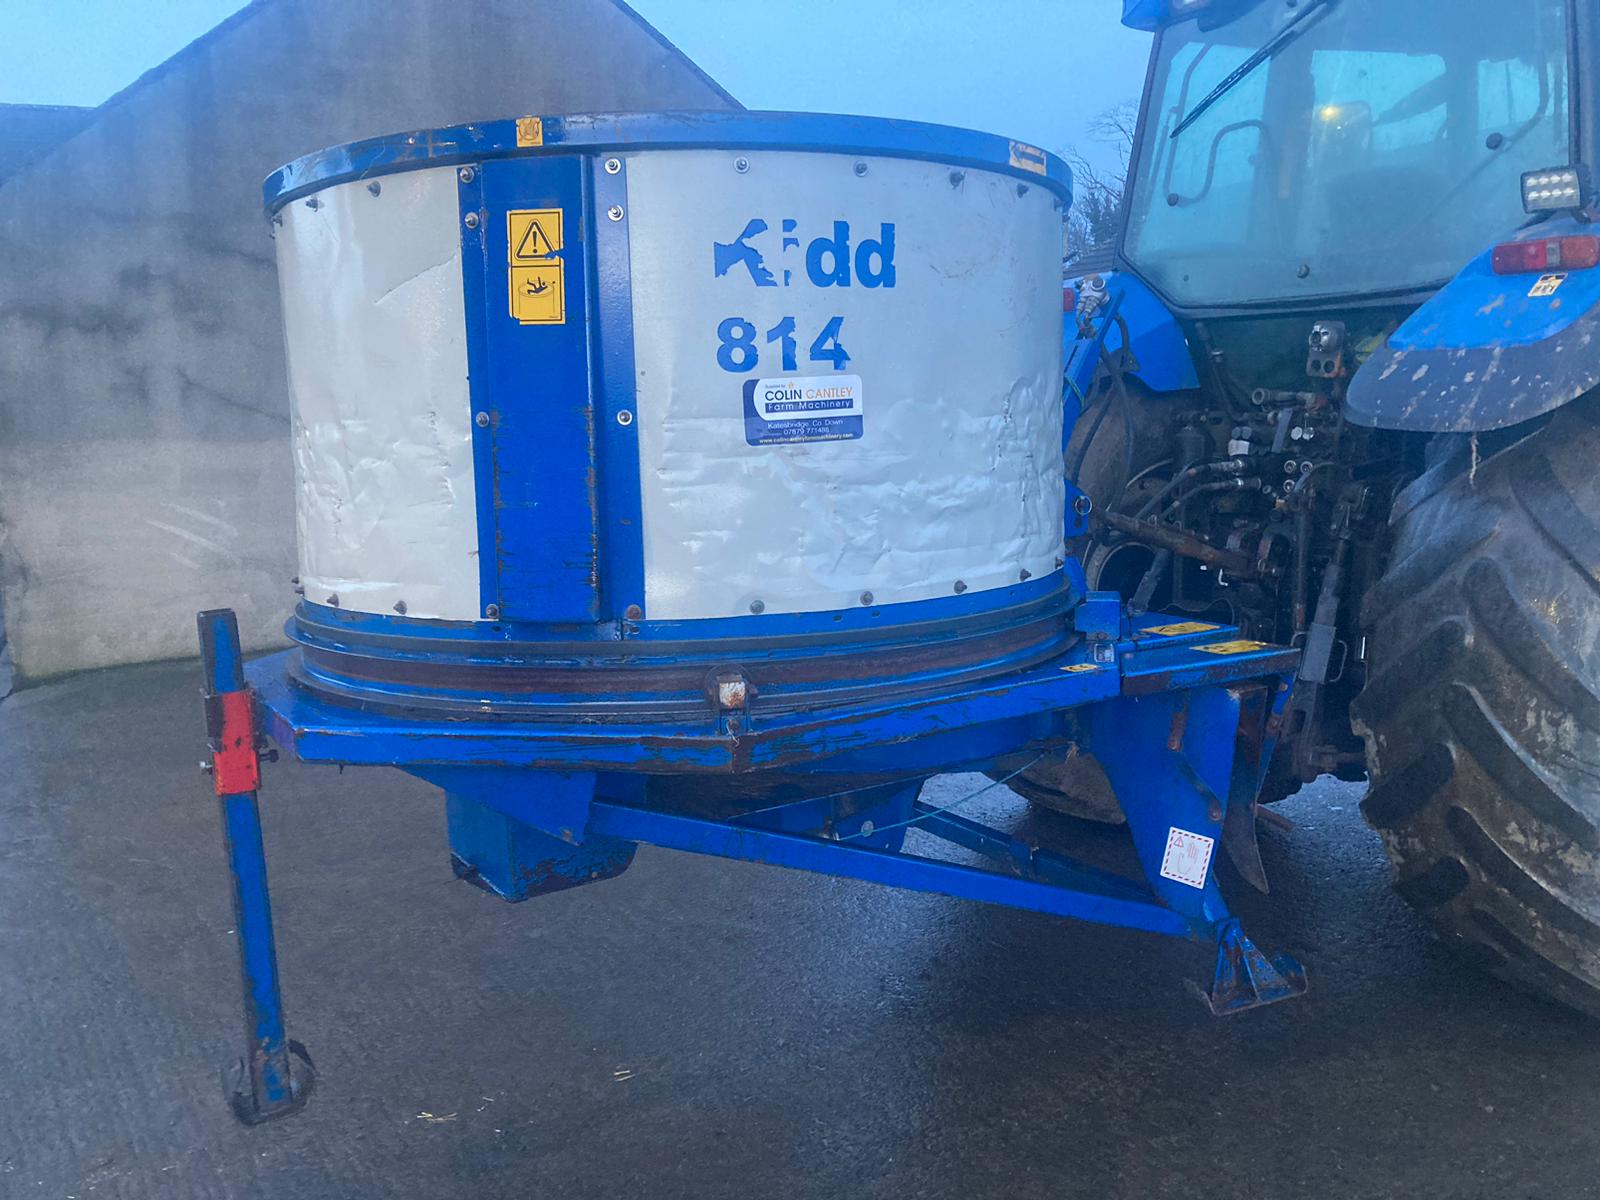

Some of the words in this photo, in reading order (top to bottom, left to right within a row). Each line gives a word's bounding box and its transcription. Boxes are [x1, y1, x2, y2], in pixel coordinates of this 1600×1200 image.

[716, 316, 851, 373] 814
[765, 389, 802, 401] COLIN
[806, 387, 853, 399] CANTLEY
[768, 403, 794, 411] Farm
[799, 400, 851, 410] Machinery
